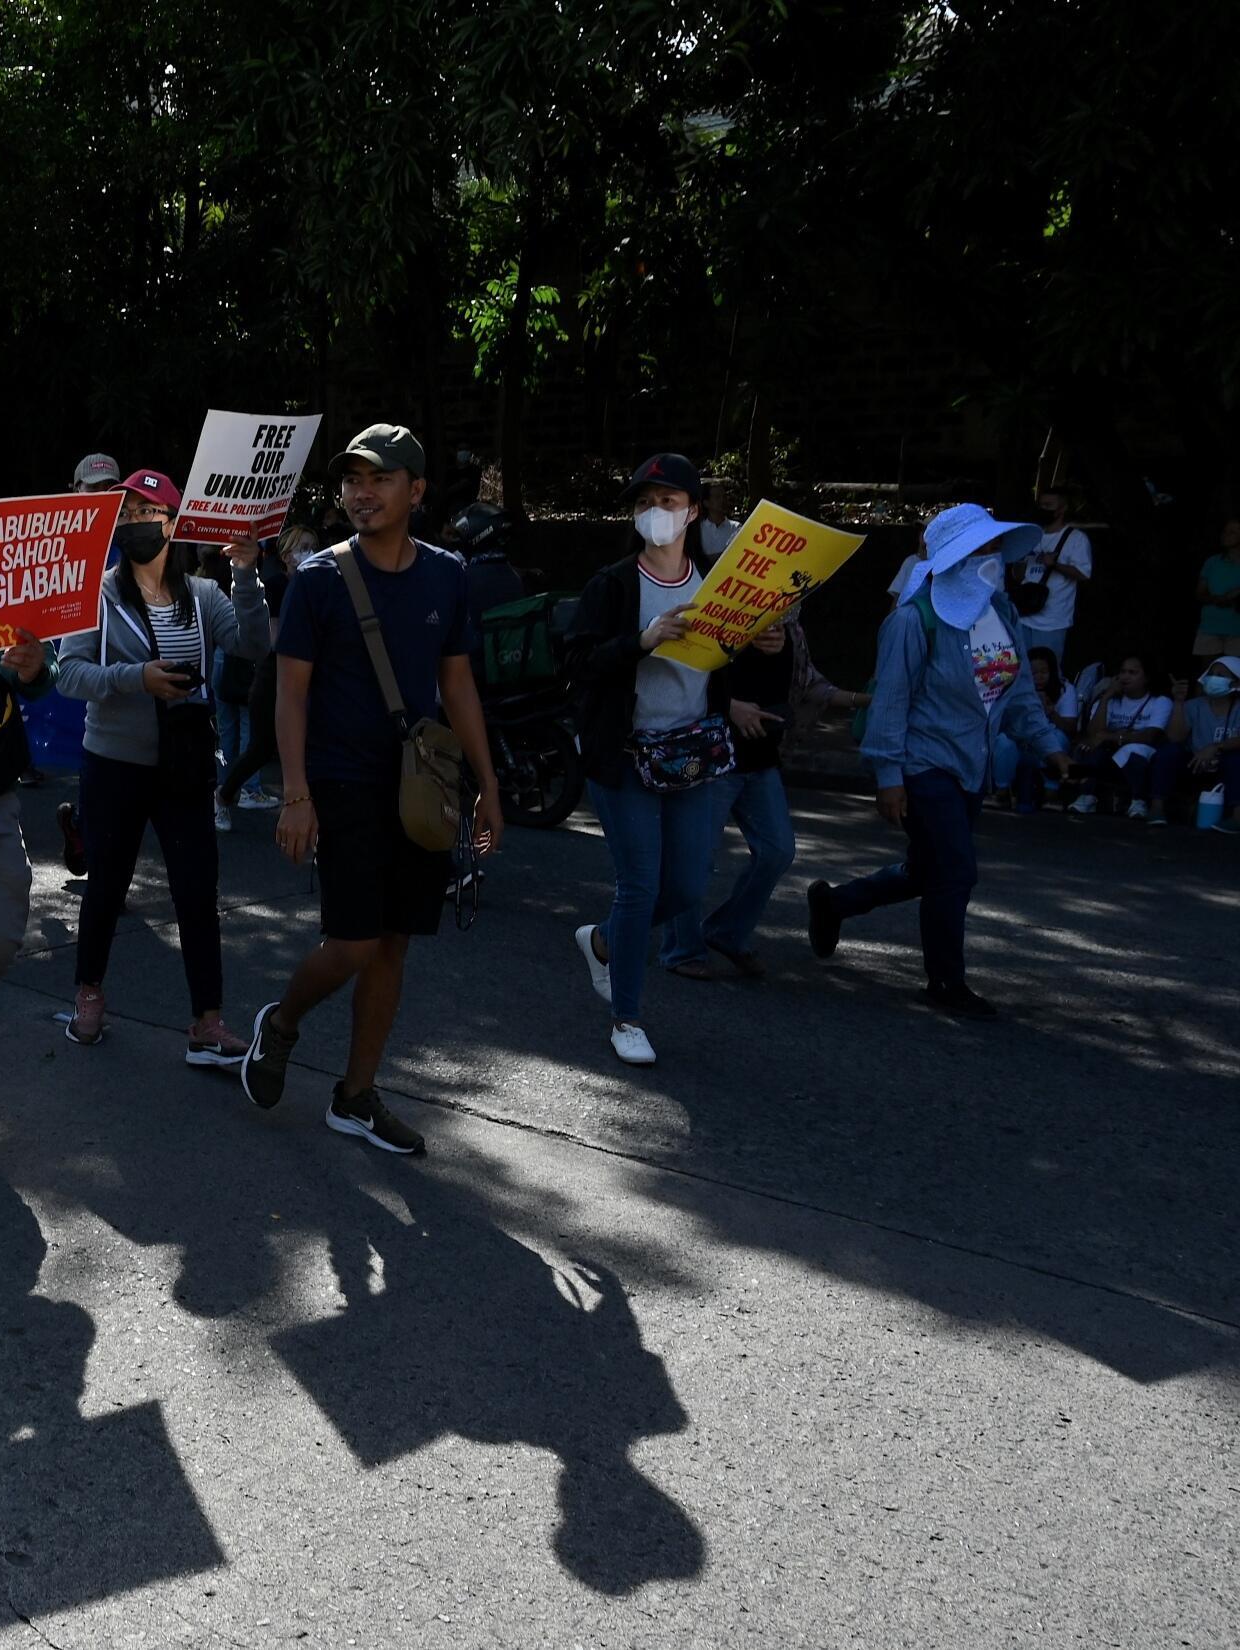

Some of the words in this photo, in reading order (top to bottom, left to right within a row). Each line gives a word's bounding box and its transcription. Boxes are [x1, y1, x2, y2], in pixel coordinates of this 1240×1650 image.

[252, 424, 296, 449] FREE
[251, 451, 285, 475] OUR
[204, 472, 296, 500] UNIONISTS!
[186, 499, 211, 512] FREE
[210, 501, 229, 514] ALL
[197, 525, 219, 534] CENTER
[218, 527, 231, 535] FOR
[753, 523, 808, 556] STOP
[1, 537, 68, 572] SAHOD,
[736, 548, 778, 579] THE
[700, 601, 756, 628] AGAINST
